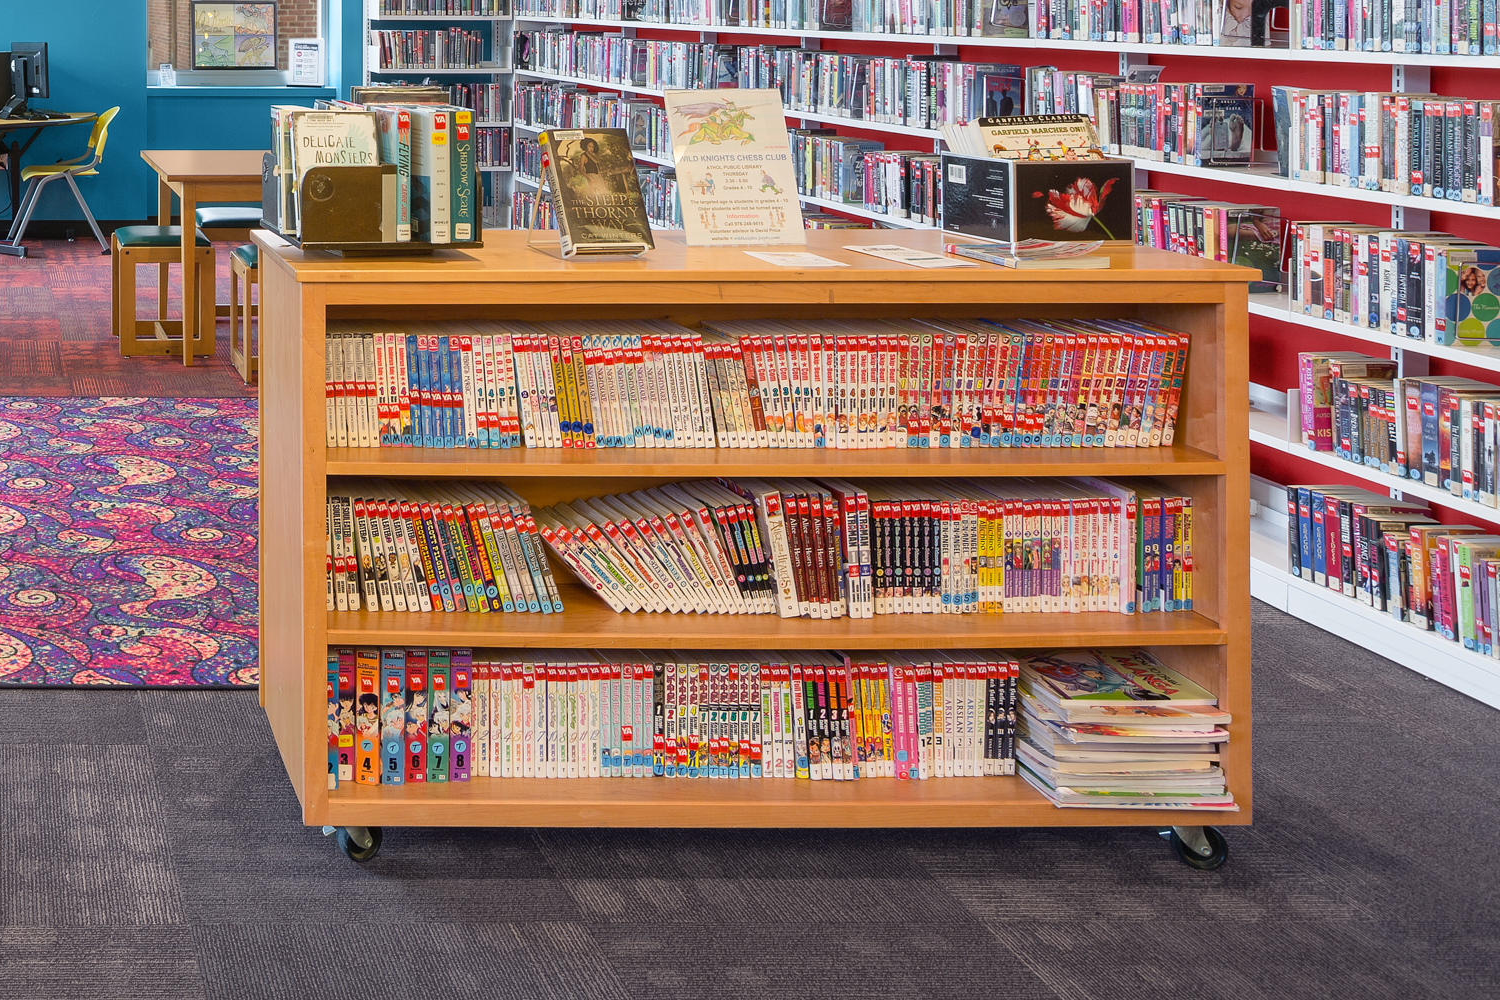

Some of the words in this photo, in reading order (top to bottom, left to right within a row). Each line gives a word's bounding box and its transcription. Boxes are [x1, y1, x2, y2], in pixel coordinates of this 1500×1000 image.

[991, 128, 1029, 136] GARFIELD
[315, 151, 373, 164] MONSTERS
[399, 142, 409, 177] FLYING
[586, 195, 628, 206] STEEP
[572, 207, 639, 219] THORNY
[592, 219, 626, 230] WAY
[1383, 269, 1391, 301] ASHFALL
[362, 757, 371, 770] 4
[389, 758, 397, 771] 5
[412, 755, 420, 768] 6
[435, 755, 442, 768] 7
[456, 755, 464, 768] 8
